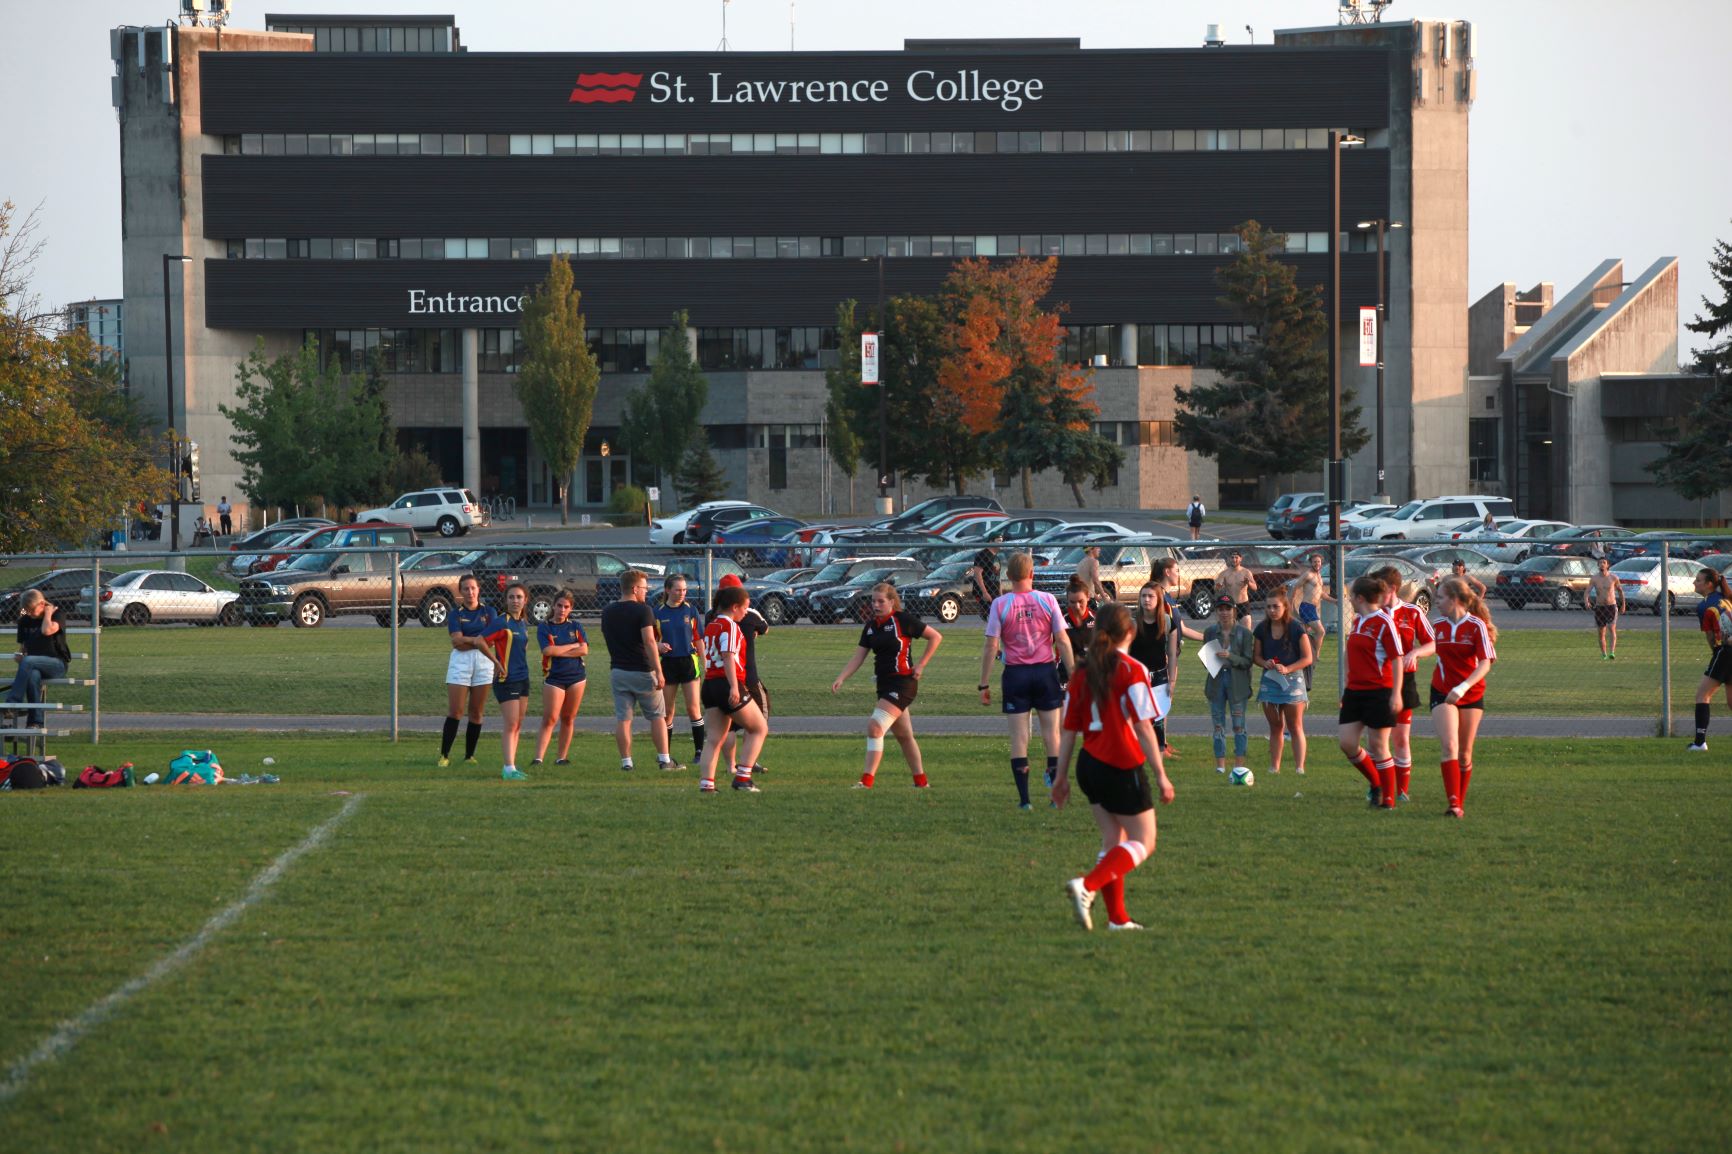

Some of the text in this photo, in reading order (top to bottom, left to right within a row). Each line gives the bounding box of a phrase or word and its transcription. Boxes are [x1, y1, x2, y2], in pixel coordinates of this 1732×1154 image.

[651, 69, 1044, 112] St. Lawrence College
